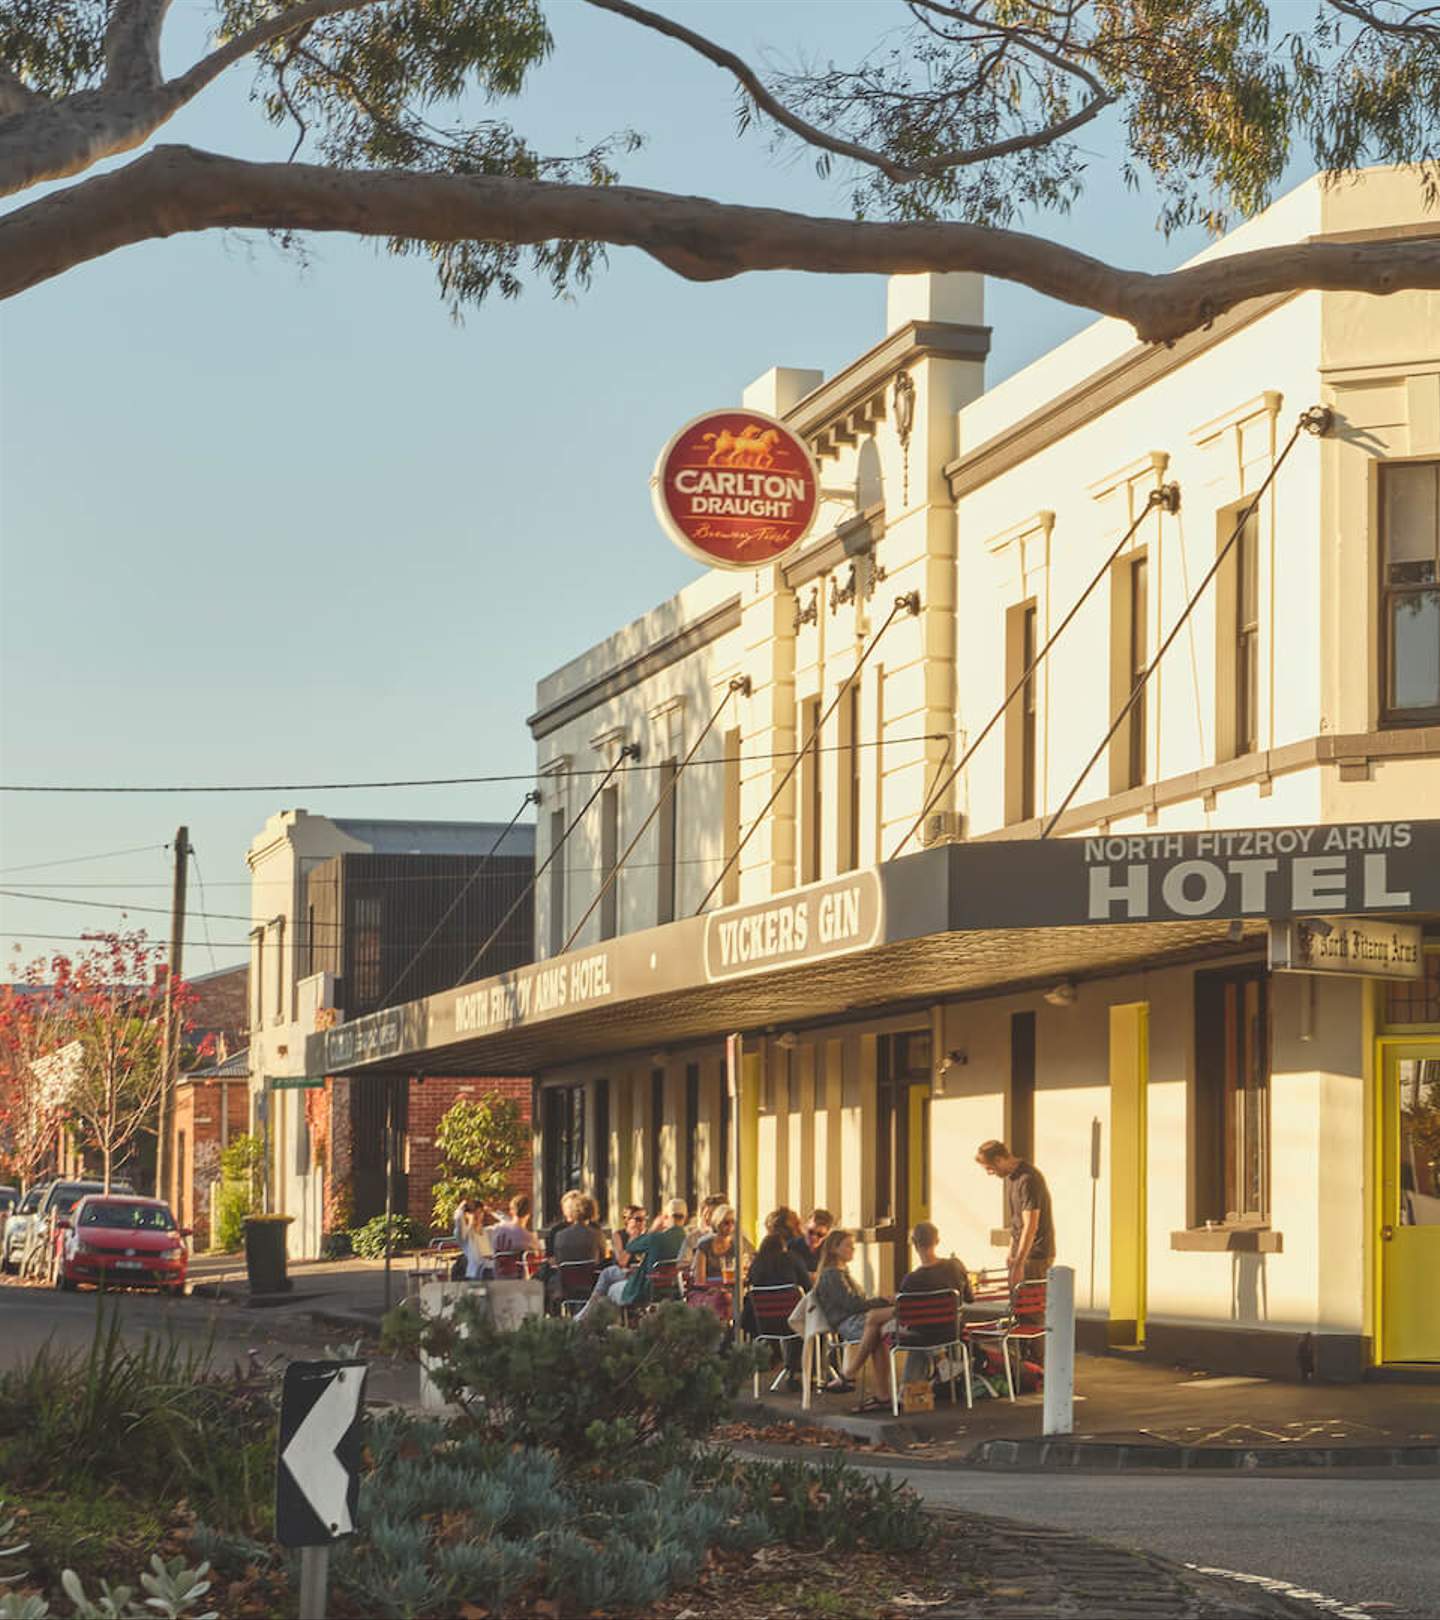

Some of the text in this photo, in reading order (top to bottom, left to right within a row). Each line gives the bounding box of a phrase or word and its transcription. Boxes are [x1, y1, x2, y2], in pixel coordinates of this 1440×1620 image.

[675, 469, 805, 501] CARLTON
[691, 496, 791, 518] DRAUGHT
[1084, 823, 1412, 863] NORTH FITZROY ARMS
[1088, 853, 1412, 919] HOTEL
[719, 887, 860, 966] VICKERS GIN
[455, 988, 489, 1032] NORTH
[534, 964, 568, 1014] ARMS
[571, 953, 611, 1003] HOTEL
